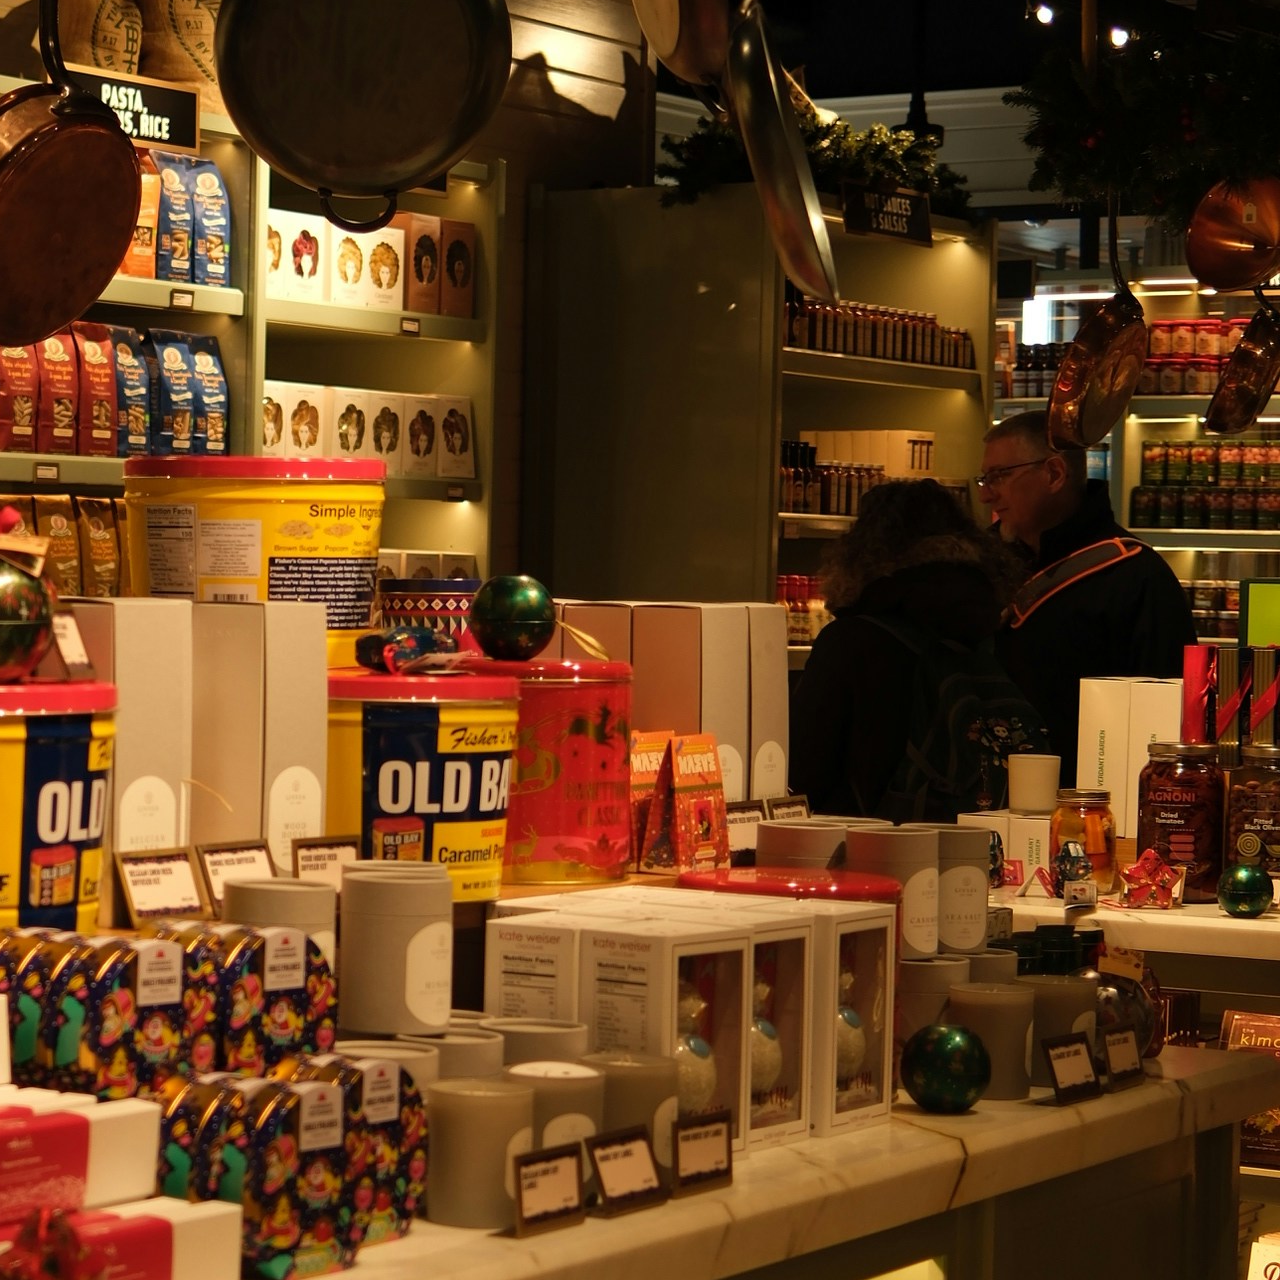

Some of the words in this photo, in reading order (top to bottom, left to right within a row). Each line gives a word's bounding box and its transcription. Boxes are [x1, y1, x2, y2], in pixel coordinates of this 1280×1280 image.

[186, 20, 203, 30] P.17
[102, 36, 117, 46] P.17
[101, 82, 148, 114] PASTA,
[140, 112, 170, 141] RICE
[882, 195, 912, 216] SAUCES
[879, 213, 908, 234] SALSAS
[146, 507, 171, 515] Nutrition
[173, 507, 192, 515] Facts
[309, 504, 356, 520] Simple
[450, 727, 508, 750] Fisher's
[1098, 759, 1106, 787] VERDANT
[378, 760, 472, 814] OLD
[479, 759, 513, 813] BA
[1148, 791, 1196, 803] AGNONI
[37, 778, 105, 844] OLD
[1155, 817, 1184, 825] Tomatoes
[383, 833, 402, 845] OLD
[439, 845, 492, 863] Caramel
[498, 928, 523, 941] kate
[526, 933, 561, 944] weiser
[592, 936, 616, 949] kate
[619, 940, 651, 952] weiser
